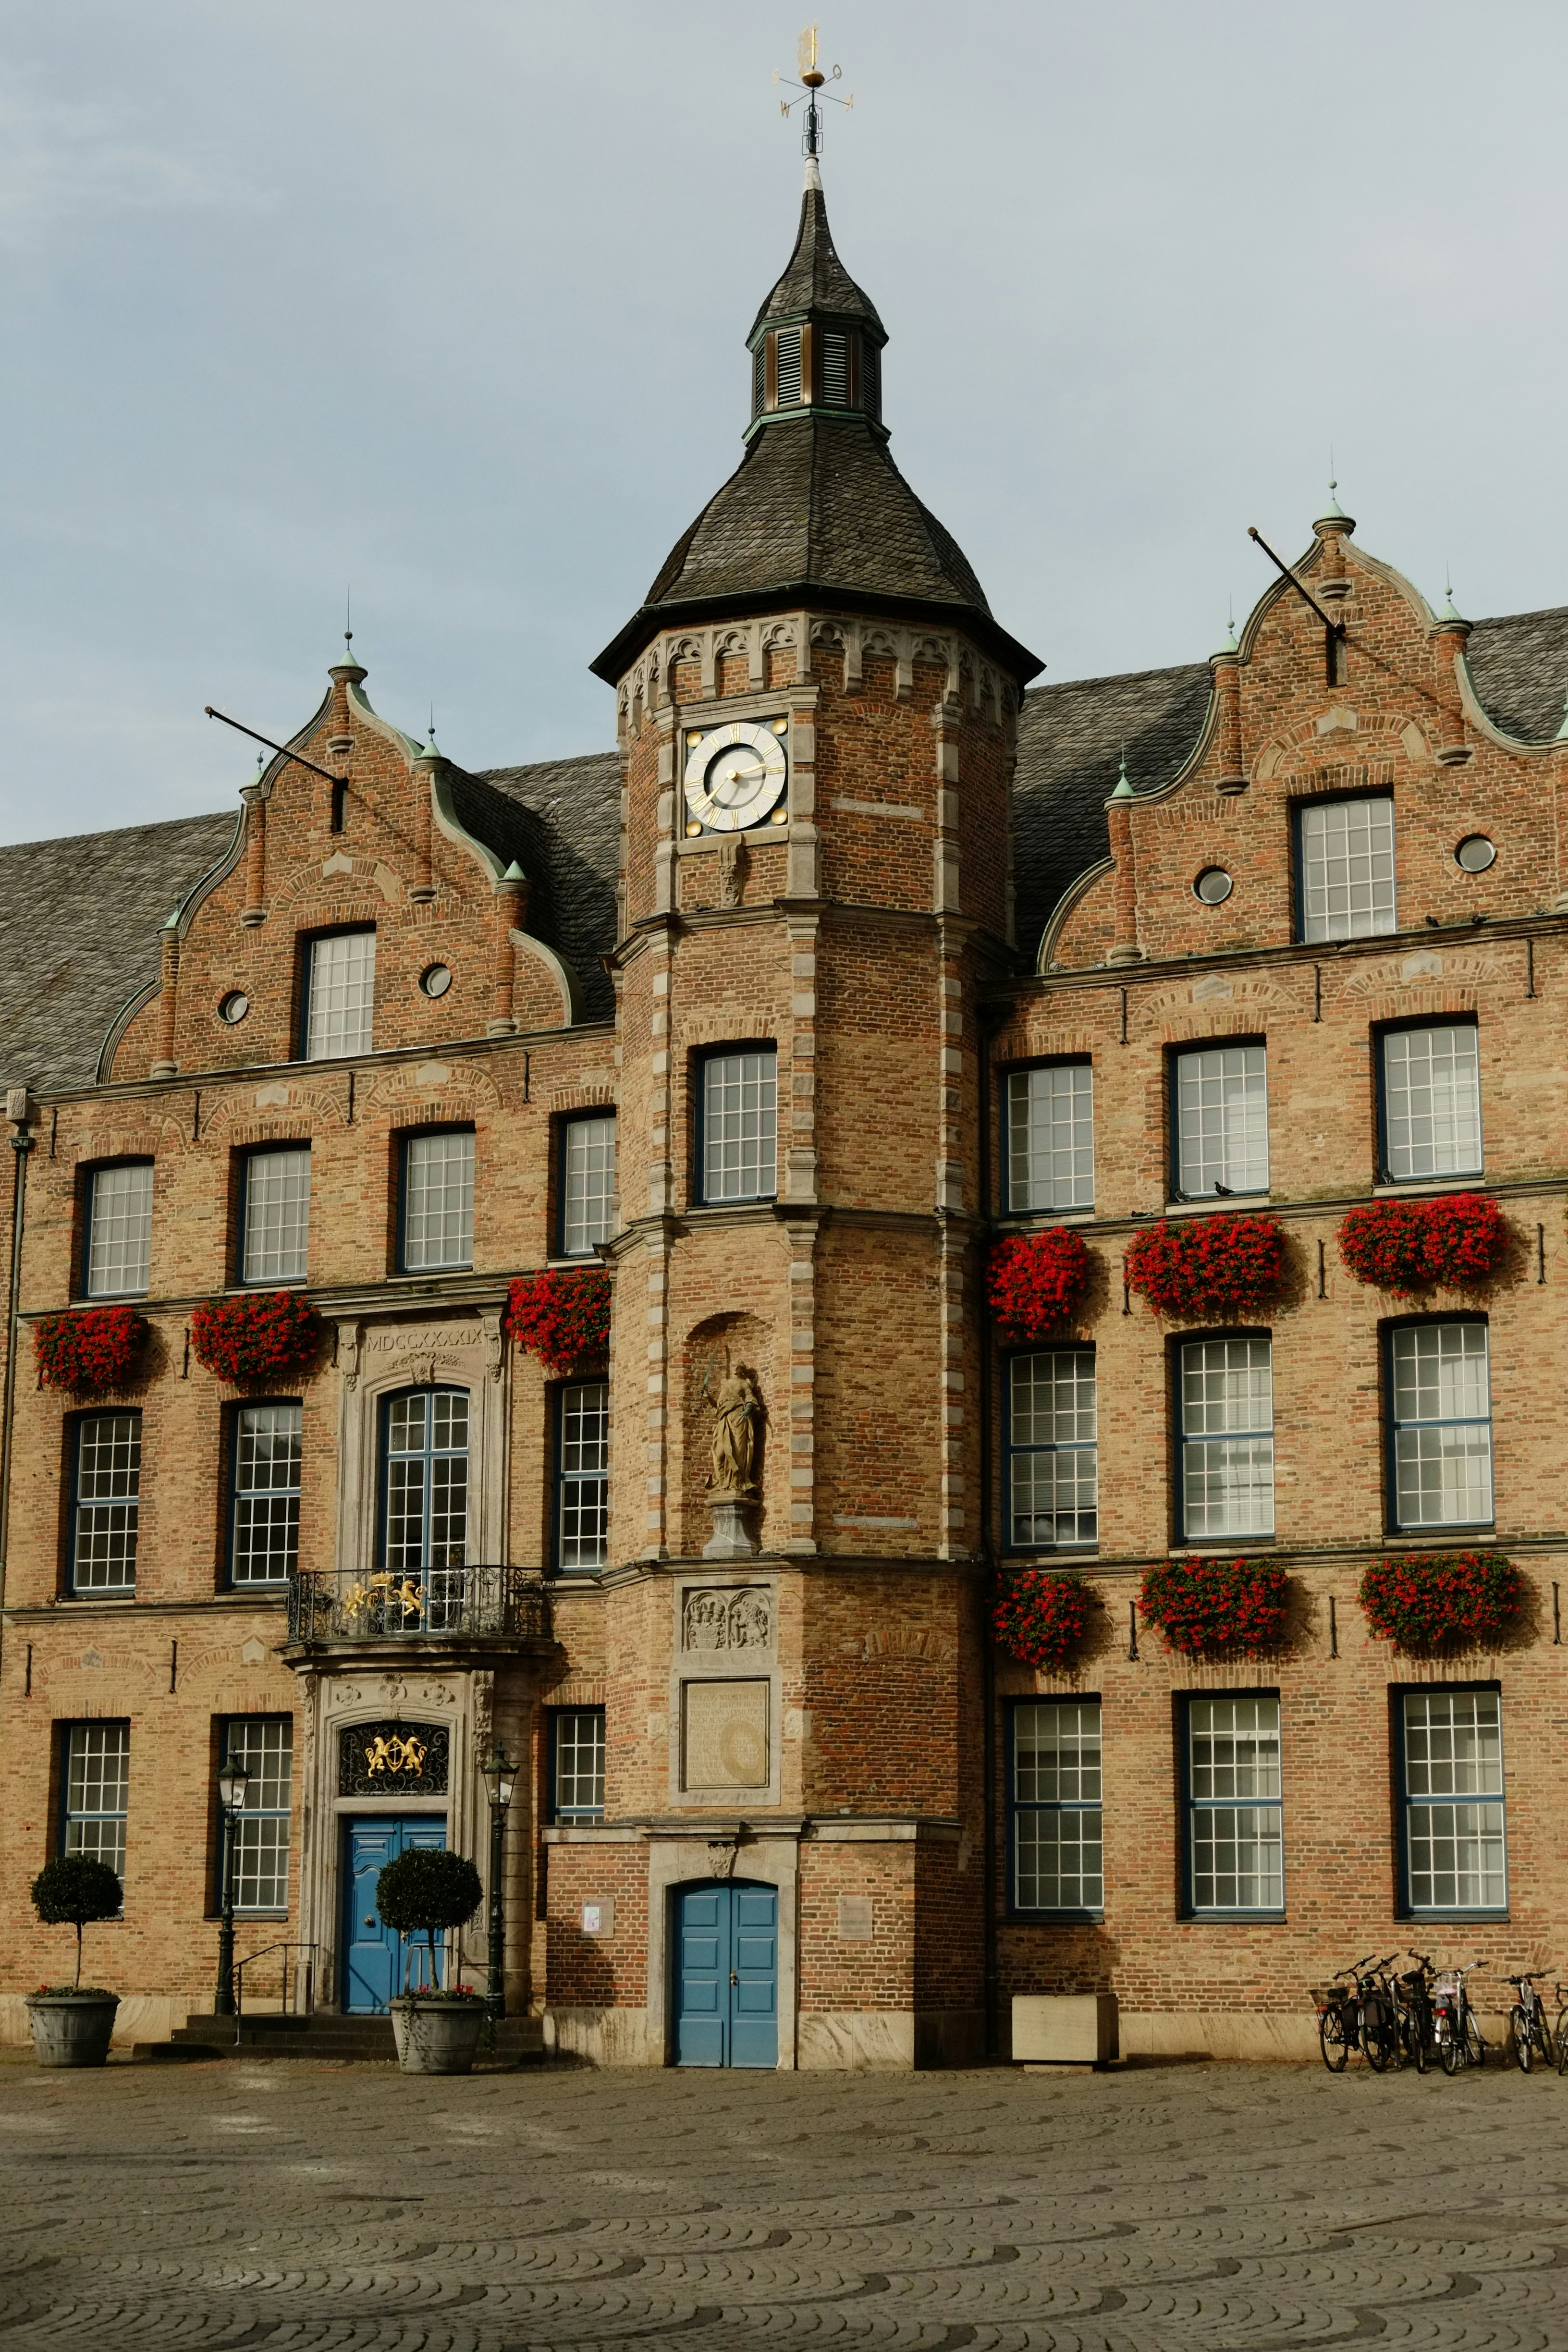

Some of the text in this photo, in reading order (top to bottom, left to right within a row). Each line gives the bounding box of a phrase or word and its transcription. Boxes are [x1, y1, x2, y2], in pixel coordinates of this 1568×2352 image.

[772, 69, 780, 86] S
[781, 100, 790, 118] W
[707, 733, 722, 752] XI
[729, 724, 740, 744] XII
[750, 727, 761, 745] I
[762, 742, 779, 758] II
[766, 766, 785, 775] III
[8, 1090, 24, 1100] 1573
[8, 1098, 24, 1108] 1749
[7, 1107, 23, 1116] 1959
[367, 1328, 482, 1352] MDCCXXXXIX
